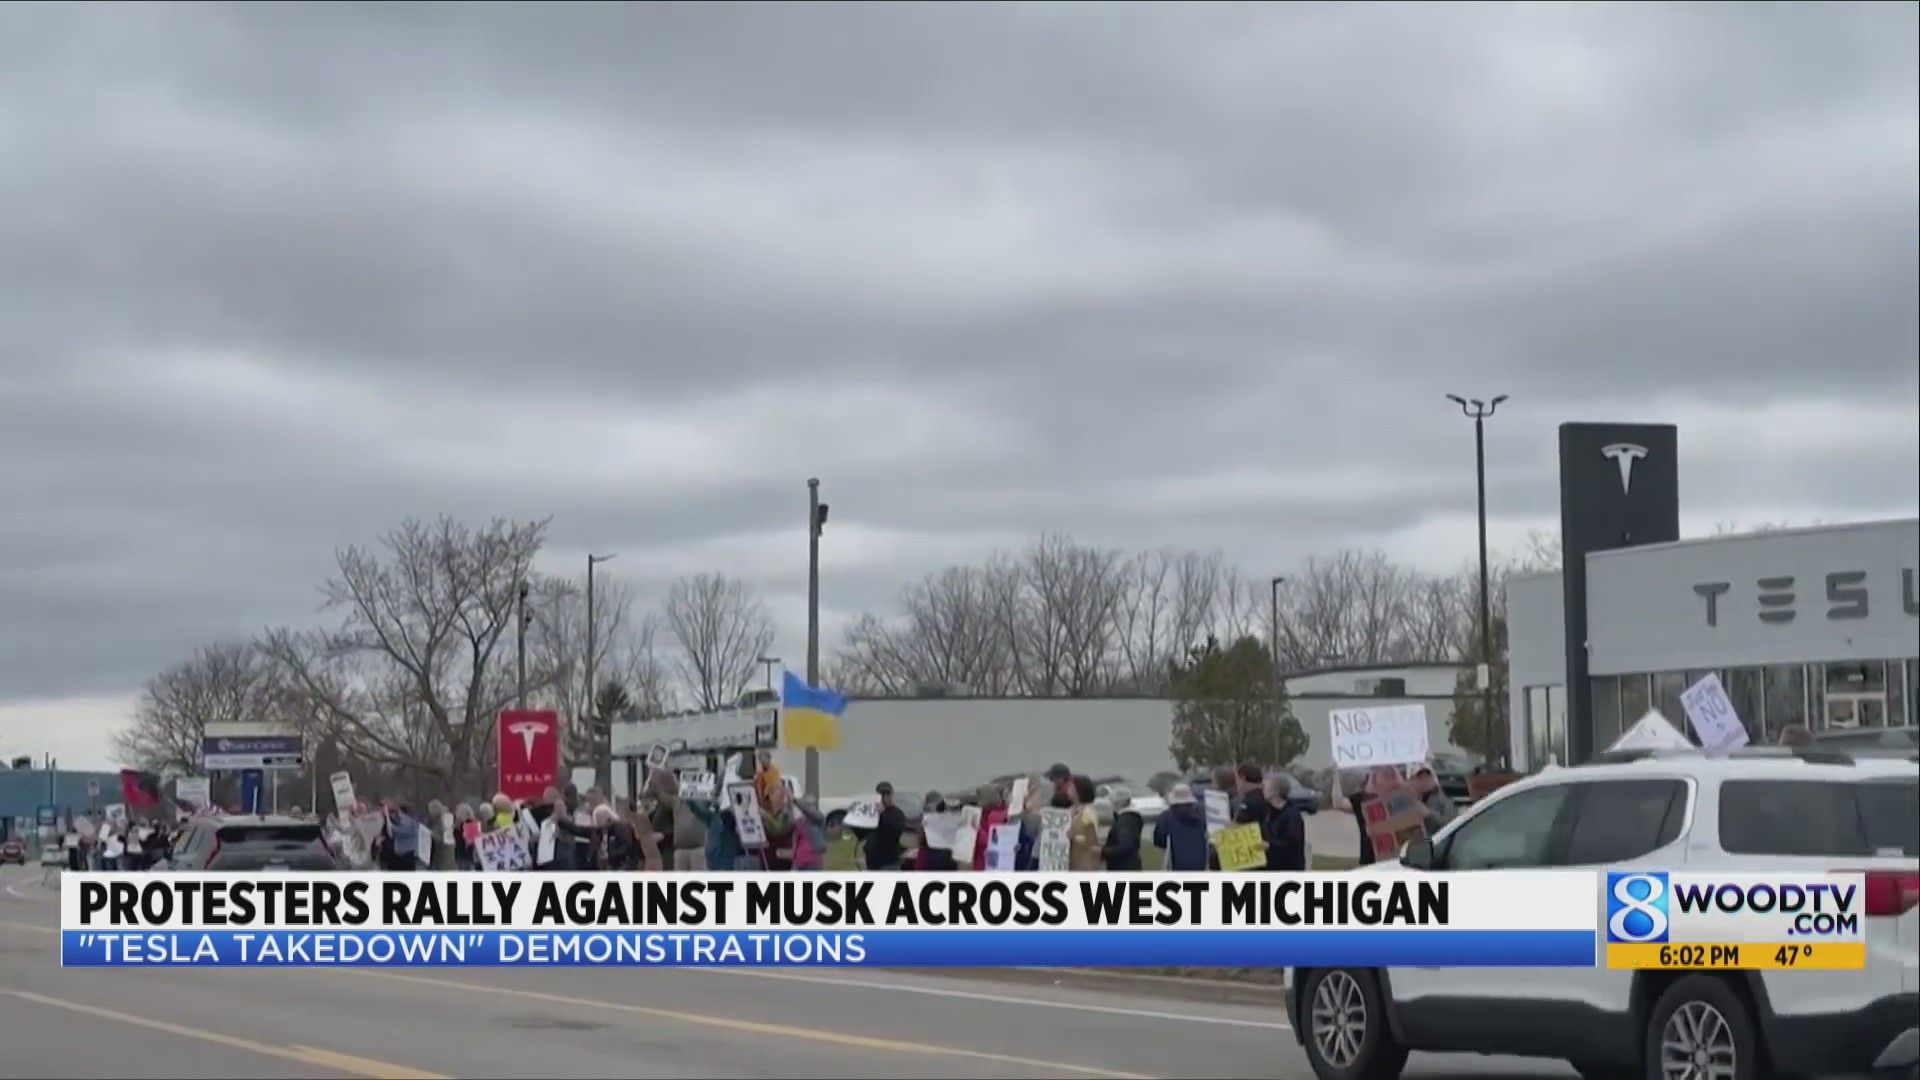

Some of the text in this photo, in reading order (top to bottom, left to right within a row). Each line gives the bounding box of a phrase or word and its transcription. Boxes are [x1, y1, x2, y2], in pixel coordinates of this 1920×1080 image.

[1698, 695, 1727, 723] NO
[1333, 710, 1373, 737] NO
[1337, 742, 1374, 762] NO
[505, 773, 552, 784] TESLA
